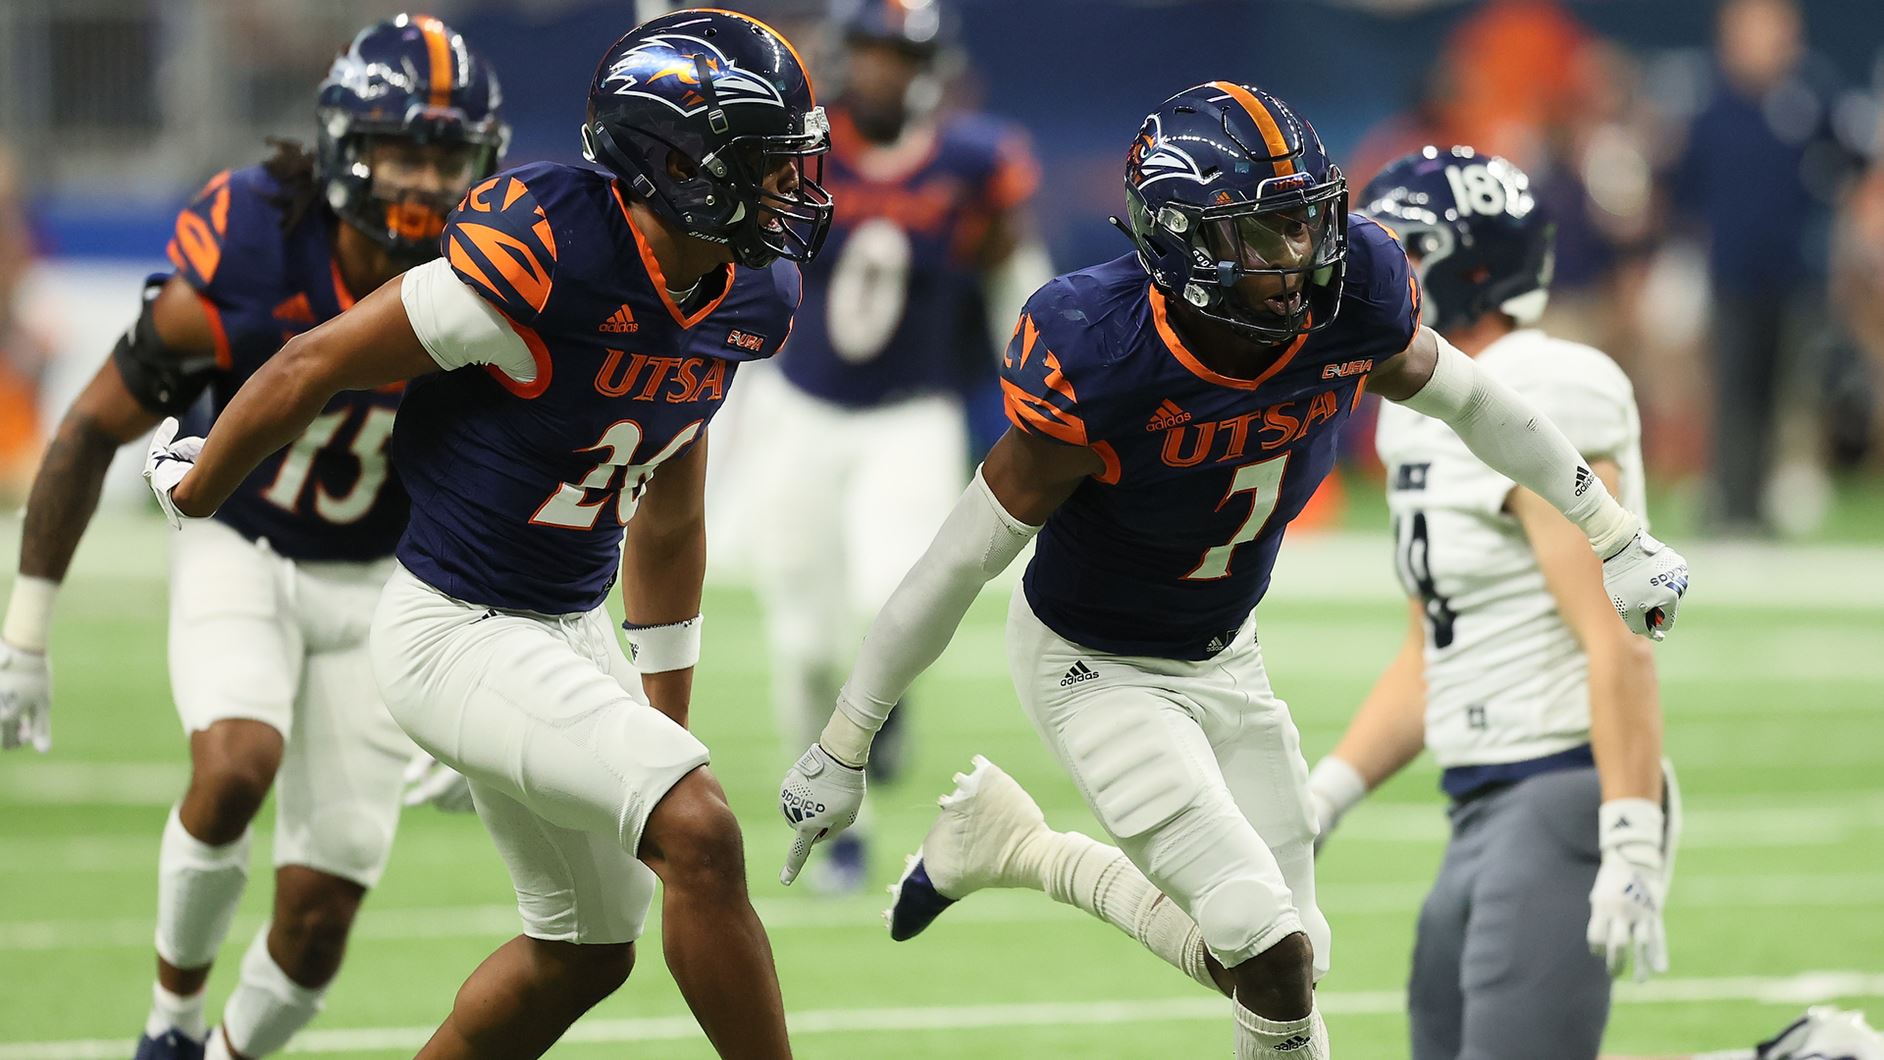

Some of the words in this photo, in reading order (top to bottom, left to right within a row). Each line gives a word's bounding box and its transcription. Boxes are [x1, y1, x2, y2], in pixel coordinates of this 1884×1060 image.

[599, 322, 639, 333] adidas
[593, 348, 727, 404] UTSA
[1145, 412, 1191, 432] adidas
[1160, 390, 1338, 468] UTSA
[262, 404, 399, 525] 15
[527, 418, 705, 531] 26
[1177, 449, 1291, 581] 7
[1060, 671, 1099, 687] adidas
[781, 788, 826, 814] adidas
